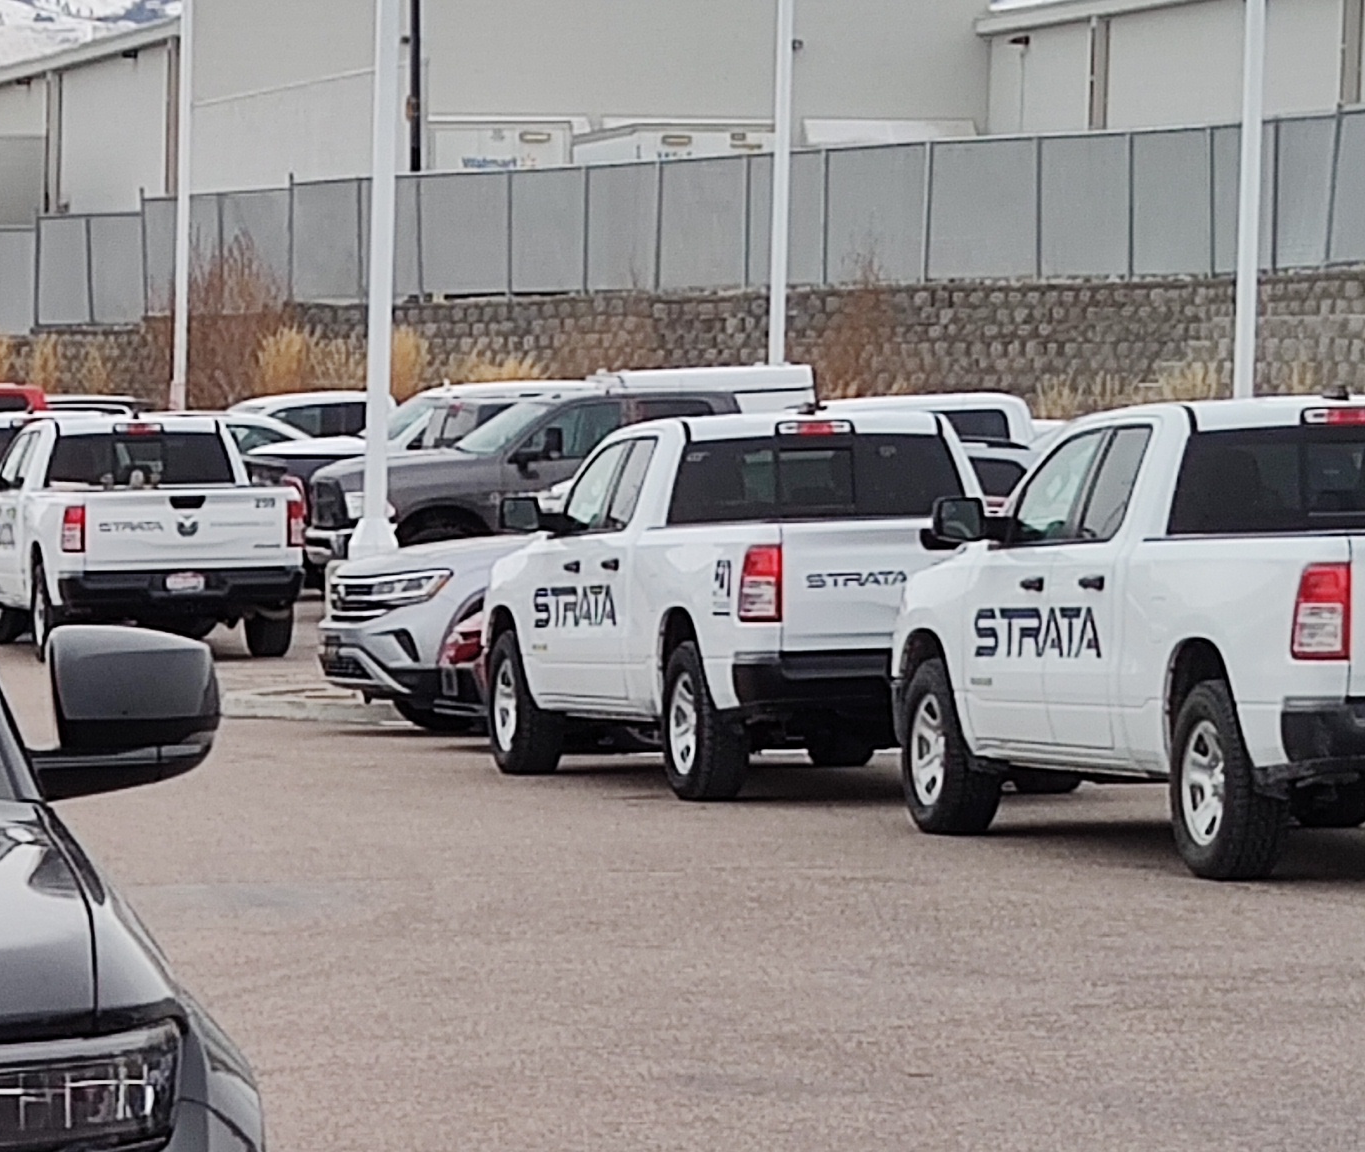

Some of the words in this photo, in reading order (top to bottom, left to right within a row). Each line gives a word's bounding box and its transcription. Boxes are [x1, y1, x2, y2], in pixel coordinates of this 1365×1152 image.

[98, 521, 164, 532] STRATA
[807, 571, 908, 589] STRATA
[534, 585, 617, 628] STRATA
[974, 606, 1102, 658] STRATA
